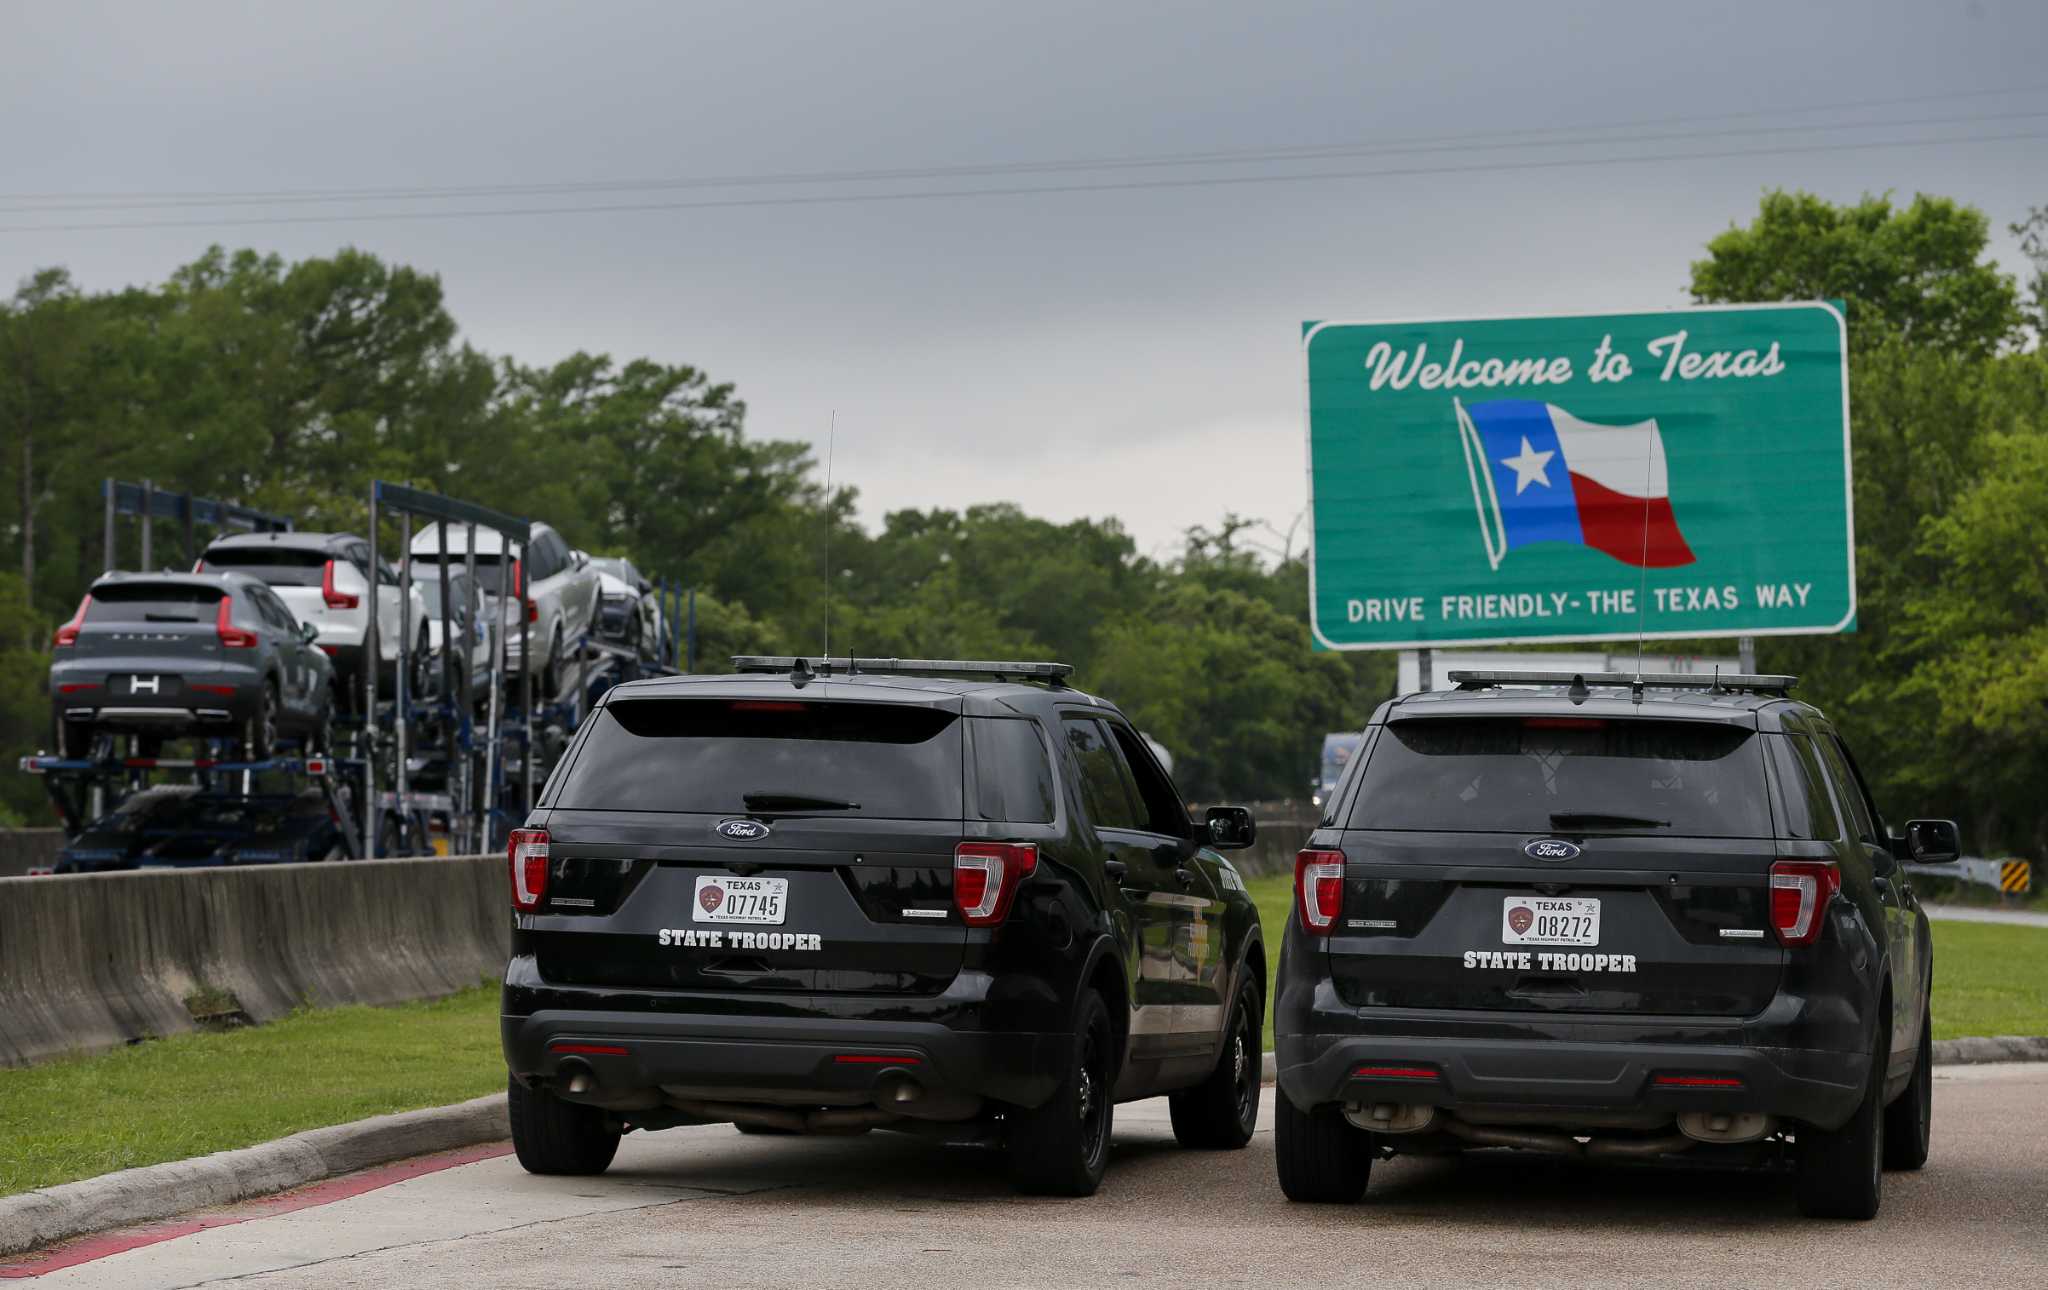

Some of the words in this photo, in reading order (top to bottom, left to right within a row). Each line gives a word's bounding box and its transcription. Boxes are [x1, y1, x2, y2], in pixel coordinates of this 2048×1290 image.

[1365, 338, 1573, 391] Welcome
[1588, 333, 1632, 383] to
[1647, 329, 1785, 382] Texas
[1347, 597, 1425, 622] DRIVE
[1654, 585, 1738, 612] TEXAS
[1756, 582, 1812, 608] WAY
[727, 823, 757, 836] Ford
[1536, 843, 1567, 857] Ford
[726, 881, 761, 890] TEXAS
[727, 895, 778, 915] 07745
[1536, 901, 1572, 911] TEXAS
[1538, 916, 1592, 937] 08272
[658, 928, 722, 948] STATE
[728, 931, 822, 950] TROOPER
[1463, 950, 1531, 970] STATE
[1538, 953, 1637, 973] TROOPER
